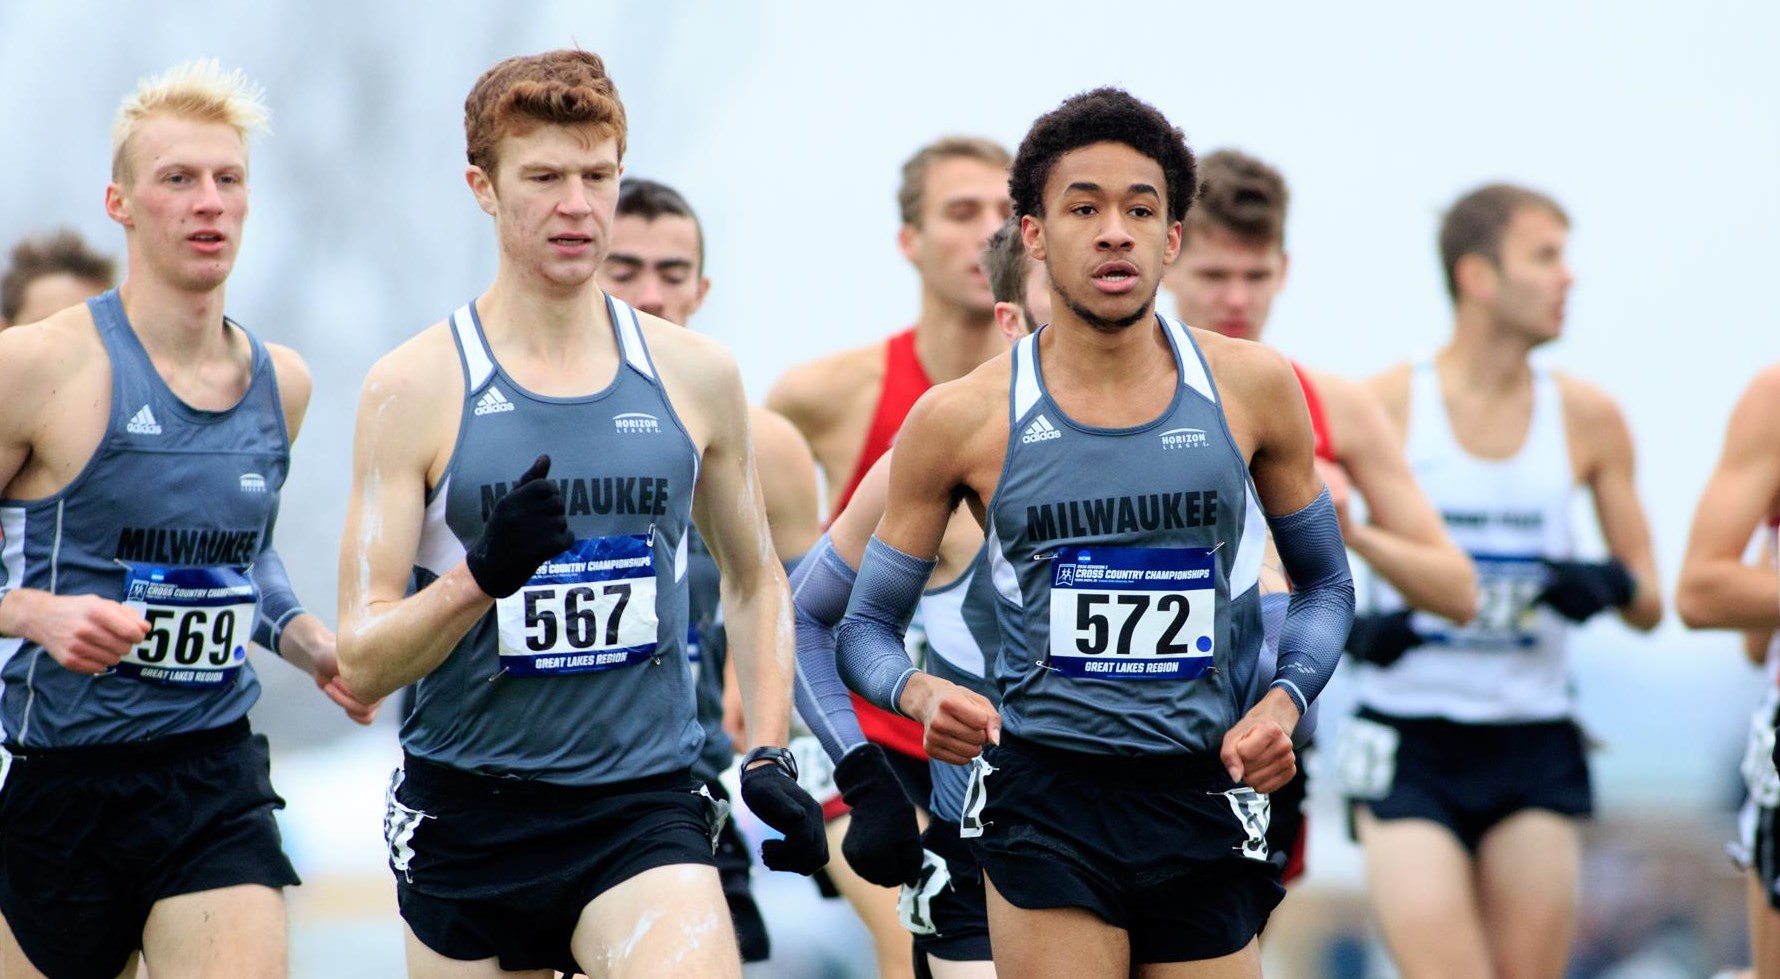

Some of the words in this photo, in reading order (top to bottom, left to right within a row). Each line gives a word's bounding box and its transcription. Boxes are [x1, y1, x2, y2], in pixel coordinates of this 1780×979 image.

[474, 402, 515, 416] adidas
[127, 423, 162, 435] adidas
[615, 419, 658, 428] HORIZON
[1022, 428, 1061, 444] adidas
[1161, 433, 1206, 445] HORIZON
[1026, 490, 1217, 542] MILWAUKEE
[115, 527, 258, 565] MILWAUKEE
[549, 562, 586, 574] COUNTRY
[587, 556, 651, 571] CHAMPIONSHIPS
[1075, 568, 1104, 578] CROSS
[1105, 569, 1144, 580] COUNTRY
[1145, 568, 1210, 580] CHAMPIONSHIPS
[173, 588, 208, 598] COUNTRY
[524, 583, 631, 652] 567
[1076, 593, 1190, 655] 572
[137, 608, 235, 666] 569
[535, 657, 566, 669] GREAT
[567, 655, 594, 668] LAKES
[596, 652, 628, 665] REGION
[1084, 661, 1115, 673] GREAT
[1116, 662, 1144, 673] LAKES
[1146, 661, 1179, 673] REGION
[140, 668, 169, 680] GREAT
[169, 669, 195, 681] LAKES
[195, 671, 223, 682] REGION
